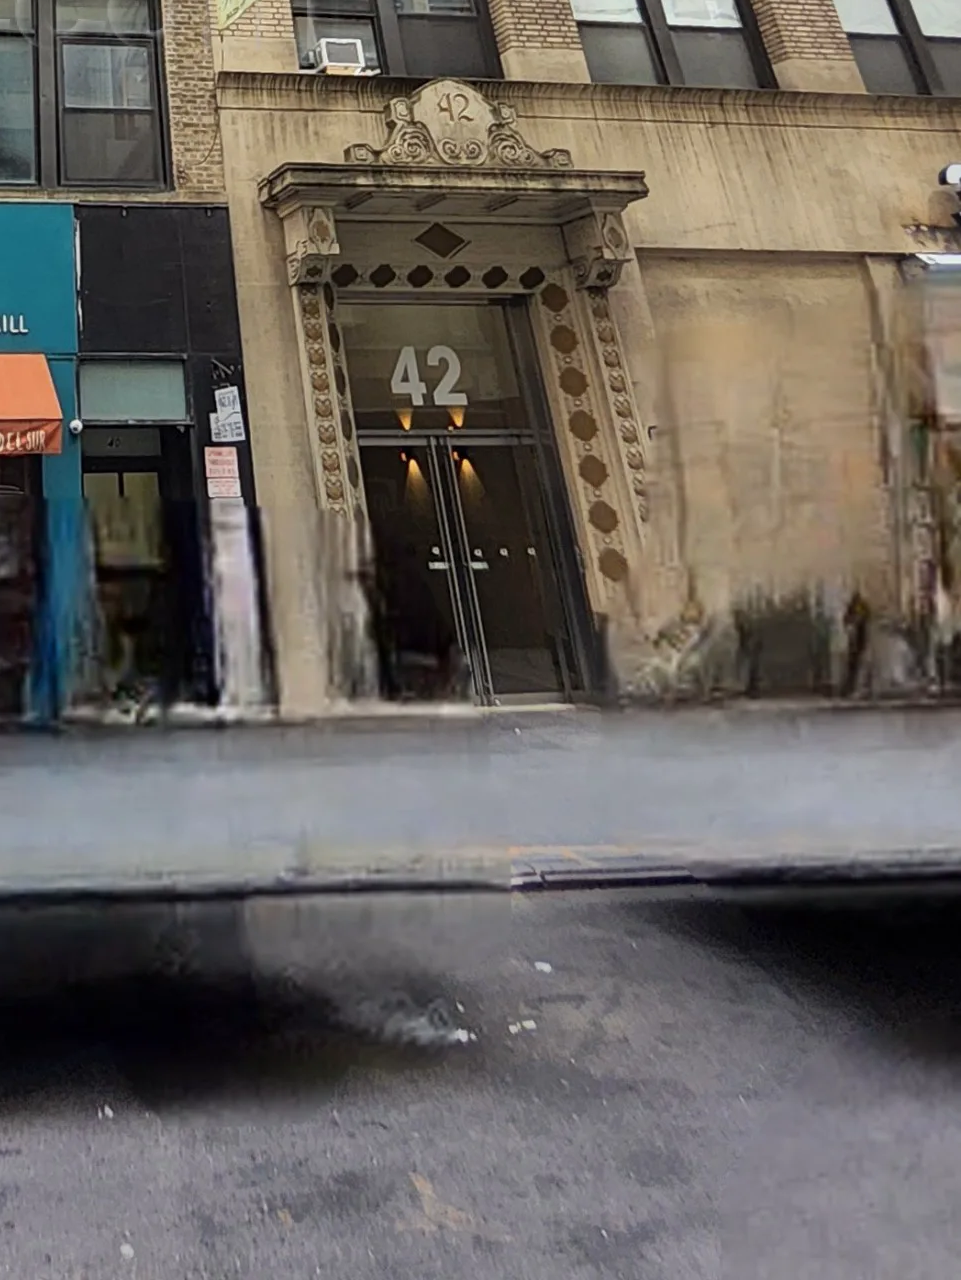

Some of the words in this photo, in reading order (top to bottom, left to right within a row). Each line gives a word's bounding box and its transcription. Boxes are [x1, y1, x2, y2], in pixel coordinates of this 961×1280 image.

[438, 92, 474, 121] 42
[390, 345, 469, 407] 42
[26, 430, 46, 451] SUR
